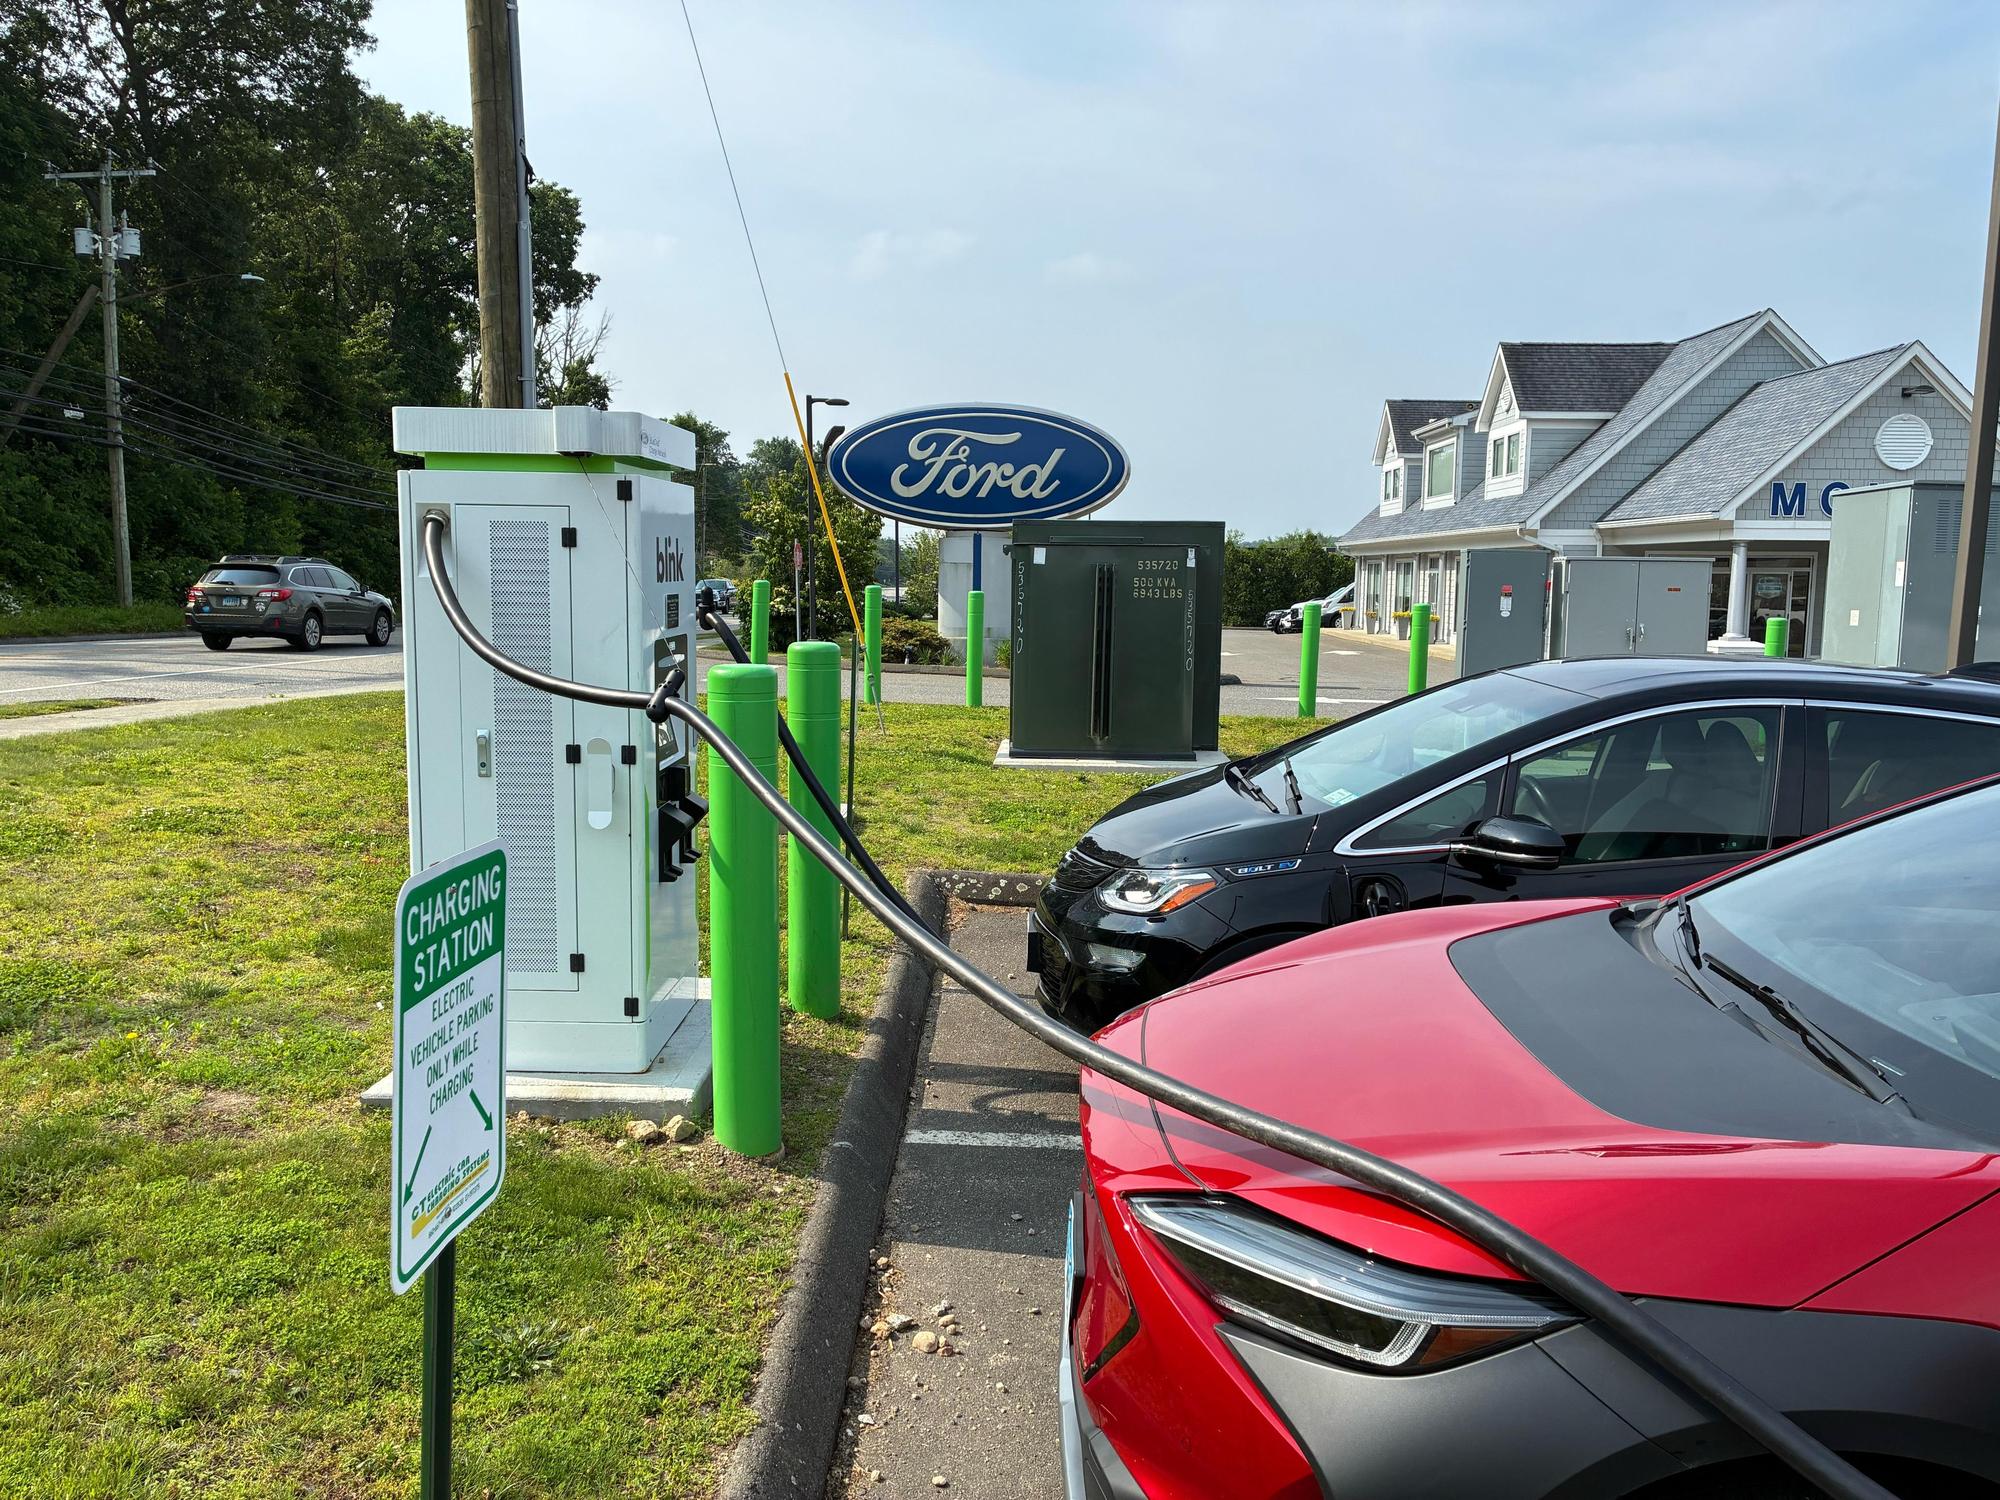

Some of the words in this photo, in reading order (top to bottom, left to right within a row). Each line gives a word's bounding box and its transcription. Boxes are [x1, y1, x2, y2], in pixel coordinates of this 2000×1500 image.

[890, 427, 1067, 500] Ford
[656, 536, 685, 584] blink
[1133, 577, 1154, 587] 500
[1157, 577, 1176, 587] KVA
[1137, 560, 1179, 570] 535720
[1133, 588, 1160, 599] 6943
[1163, 588, 1183, 599] LBS
[1238, 864, 1274, 874] BOLT
[1278, 860, 1297, 869] EV
[407, 865, 501, 946] CHARGING
[414, 912, 494, 992] STATION
[432, 976, 475, 1022] ELECTRIC
[411, 1020, 454, 1070] VEHICHLE
[457, 993, 494, 1035] PARKING
[426, 1052, 450, 1088] ONLY
[452, 1031, 479, 1067] WHILE
[429, 1063, 474, 1115] CHARGING
[427, 1175, 461, 1213] CHARGING
[462, 1148, 490, 1179] SYSTEMS
